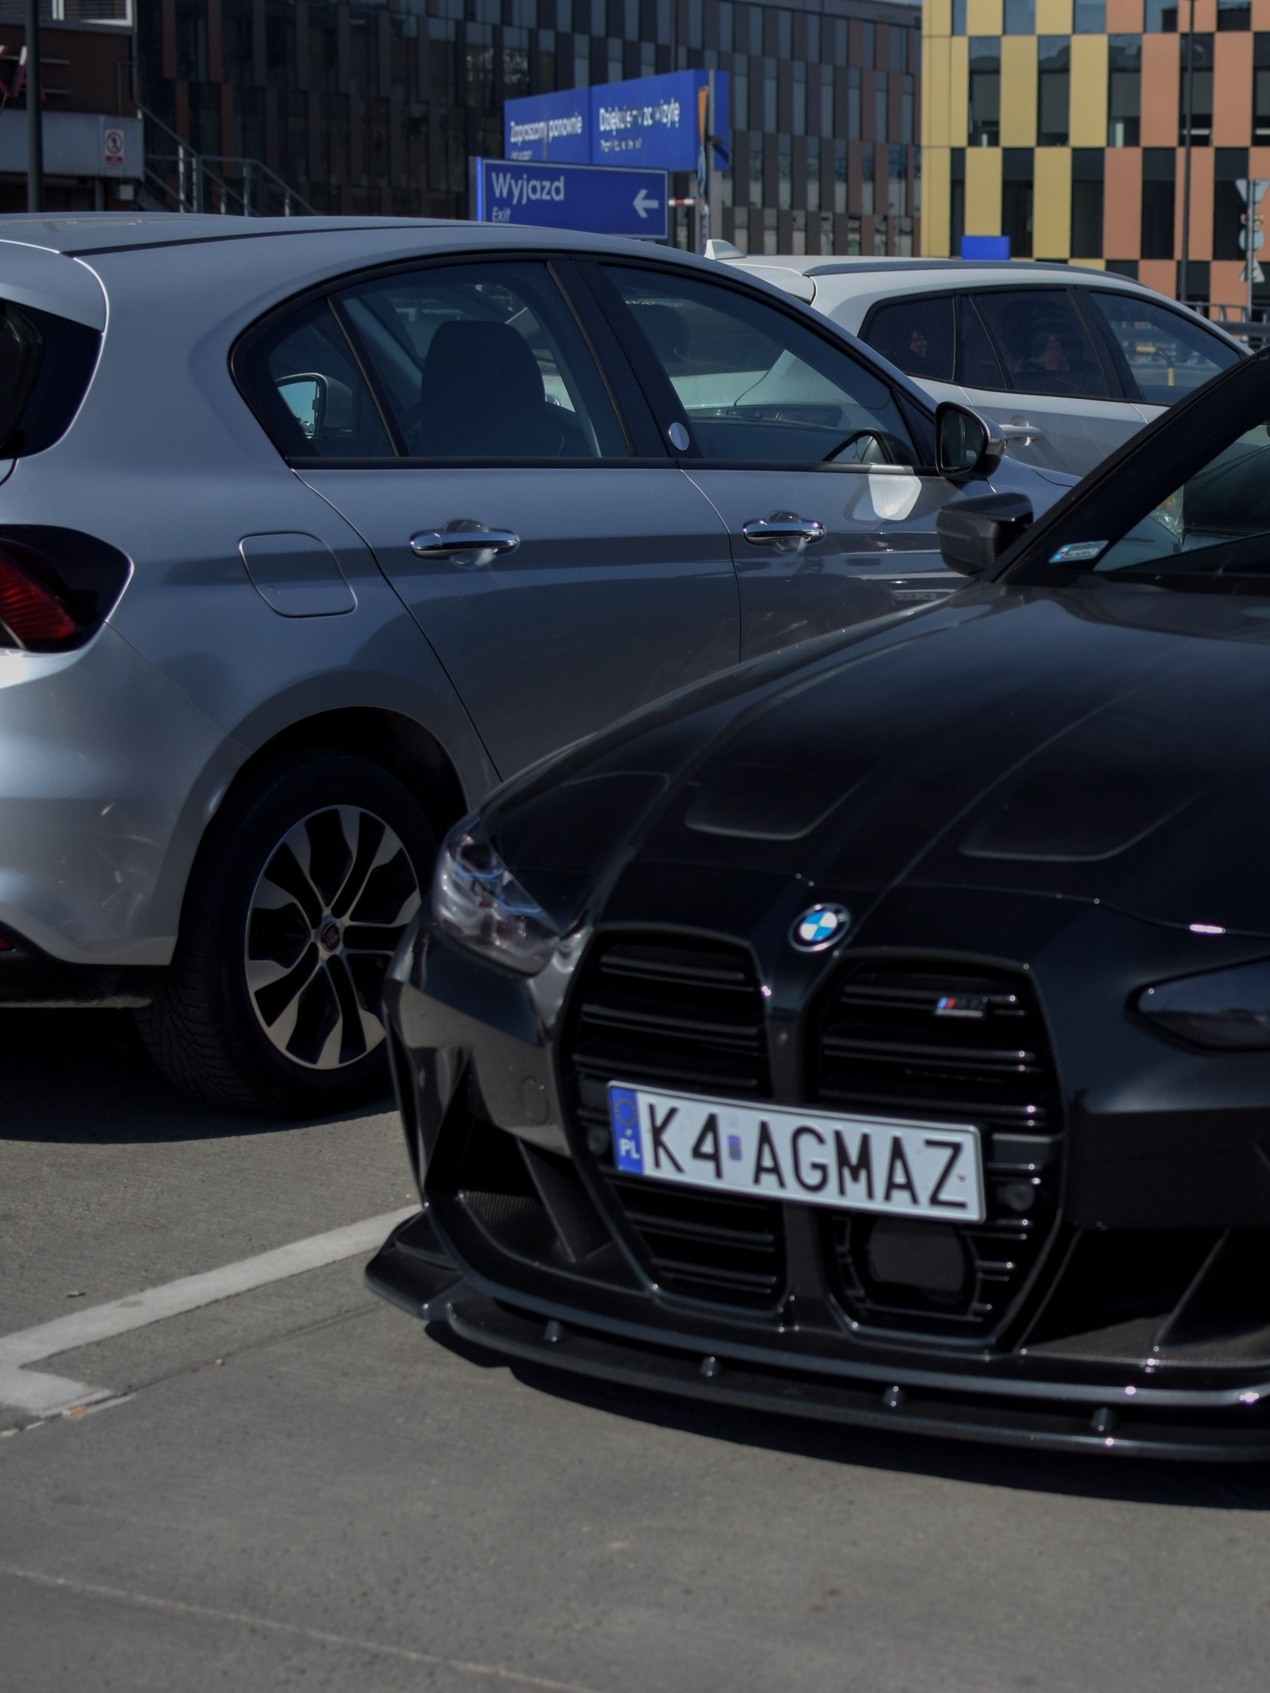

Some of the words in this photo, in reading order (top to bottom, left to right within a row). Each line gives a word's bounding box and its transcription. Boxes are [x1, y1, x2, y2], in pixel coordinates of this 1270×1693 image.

[492, 172, 565, 205] Wyjazd
[492, 207, 511, 223] Exit
[619, 1137, 641, 1160] PL
[648, 1102, 723, 1180] K4
[753, 1119, 967, 1209] AGMAZ
